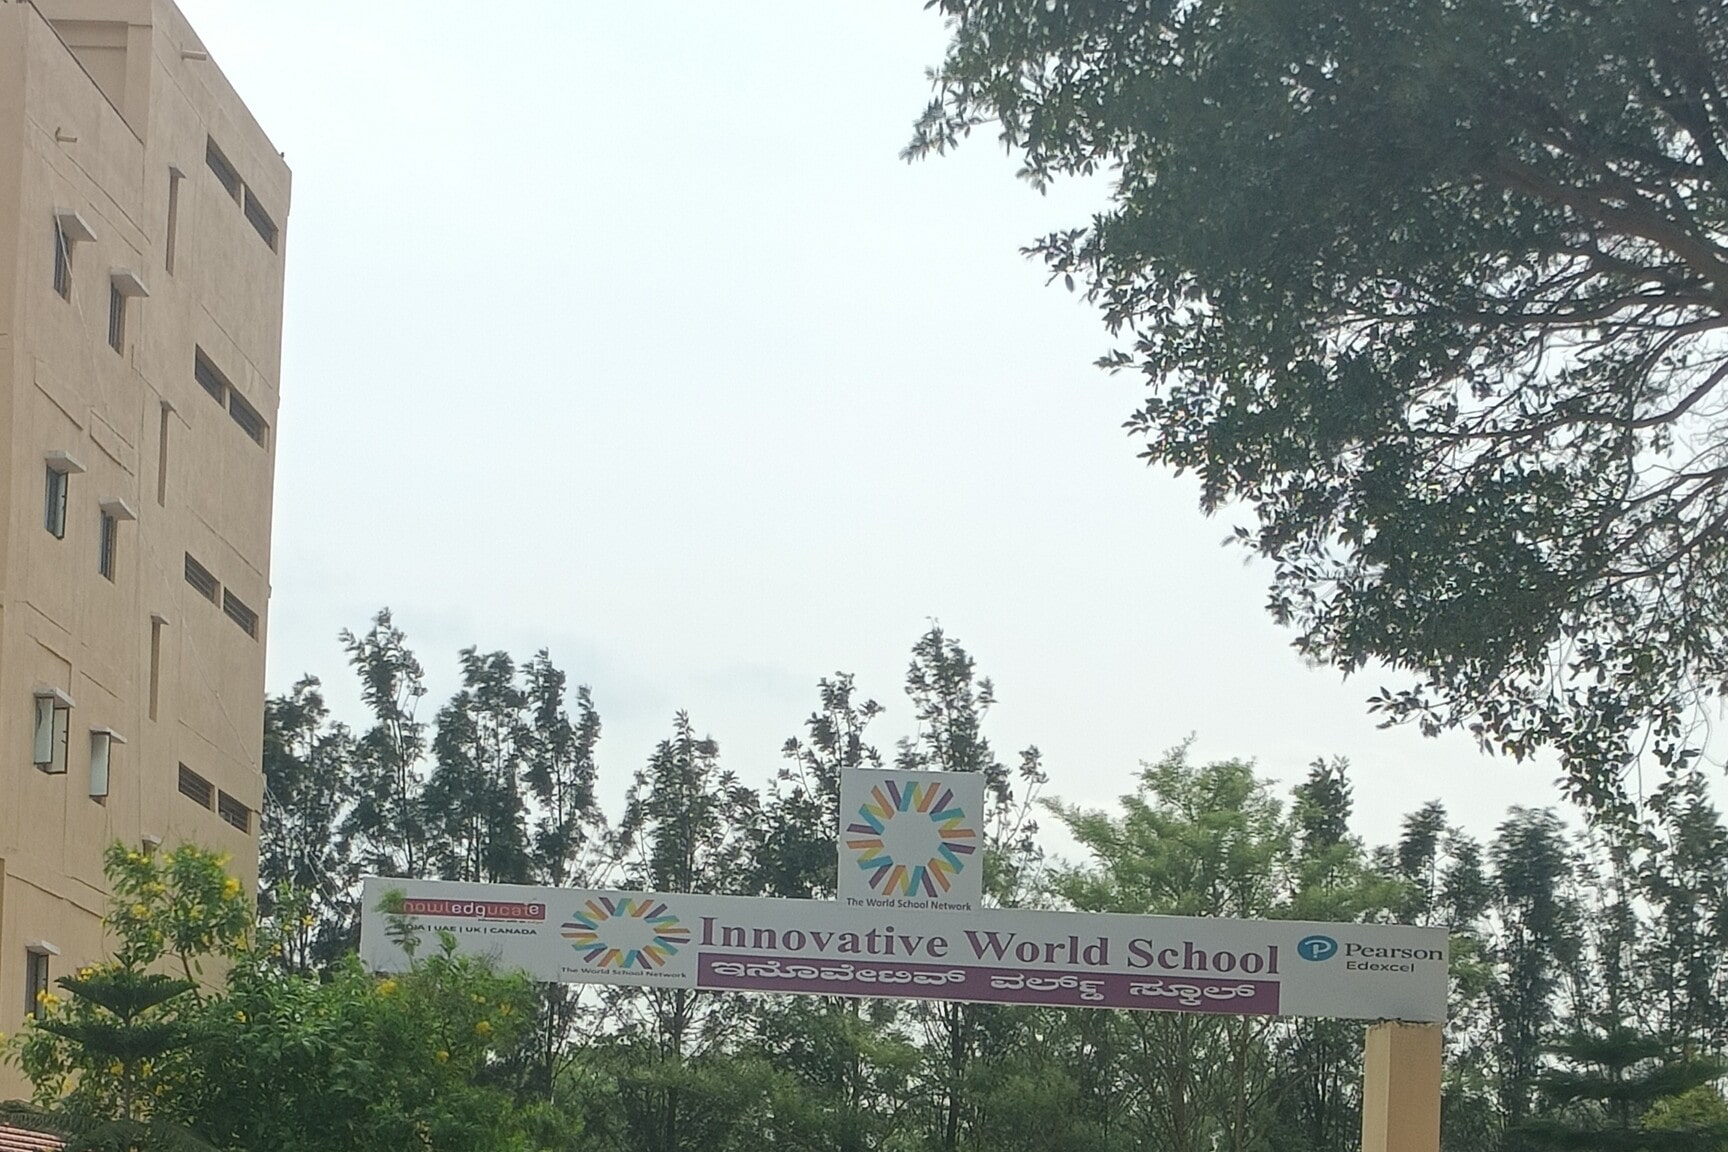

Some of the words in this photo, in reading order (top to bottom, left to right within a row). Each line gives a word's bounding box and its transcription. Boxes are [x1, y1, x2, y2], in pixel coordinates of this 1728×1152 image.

[846, 897, 864, 907] The
[866, 898, 895, 908] World
[897, 899, 929, 909] School
[931, 901, 972, 911] Network
[434, 924, 456, 932] UAE
[489, 927, 537, 935] CANADA
[698, 916, 949, 958] Innovative
[963, 930, 1110, 966] World
[1126, 938, 1280, 974] School
[1345, 942, 1444, 961] Pearson
[1346, 960, 1415, 973] Edexcel
[1129, 979, 1256, 1006] ಸ್ಕೂಲ್
